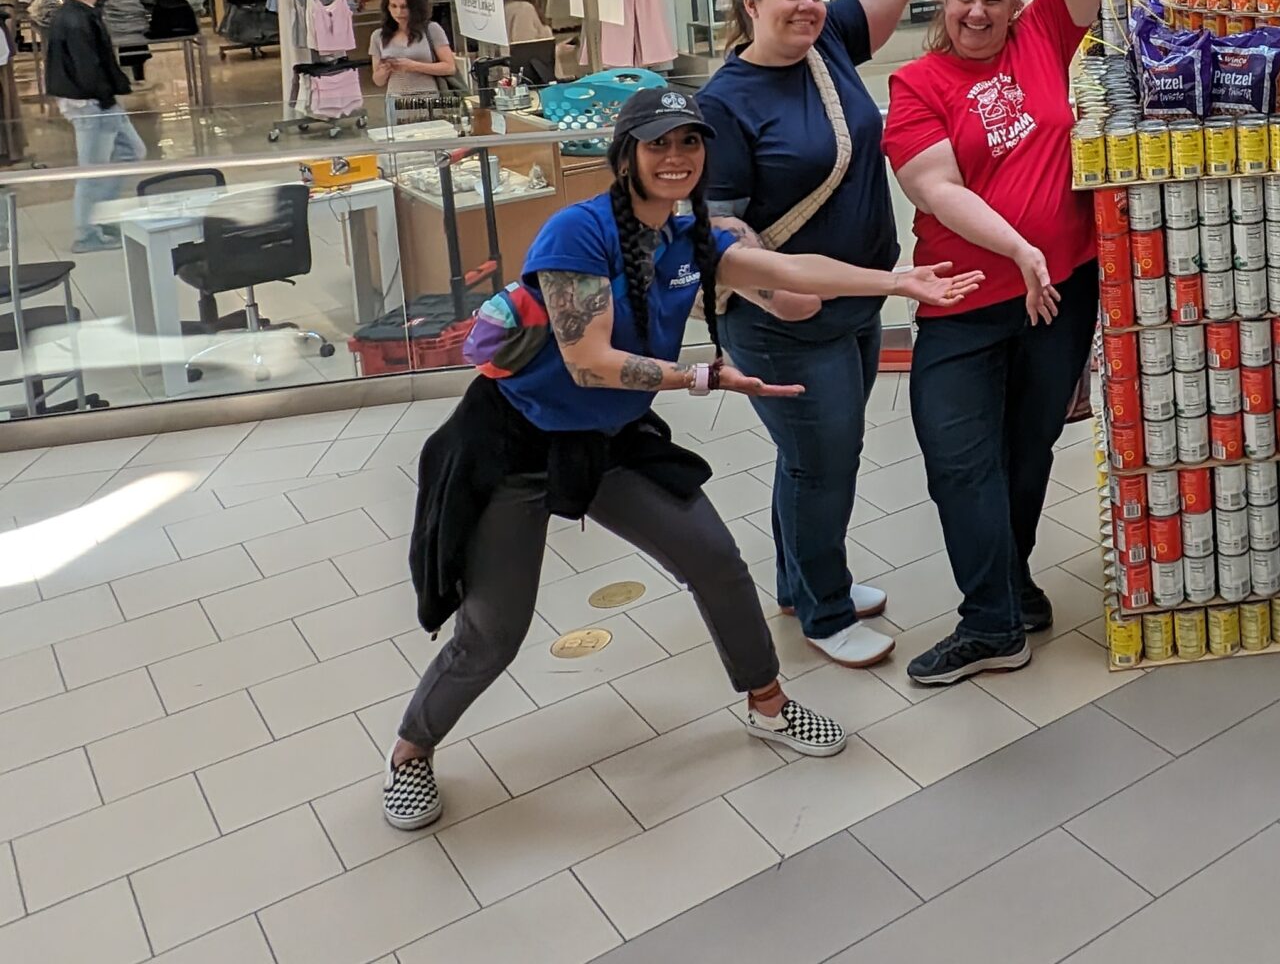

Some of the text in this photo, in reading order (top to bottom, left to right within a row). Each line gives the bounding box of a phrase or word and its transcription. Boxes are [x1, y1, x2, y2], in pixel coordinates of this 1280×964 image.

[1213, 69, 1253, 86] Pretzel
[986, 111, 1035, 148] MY JAM
